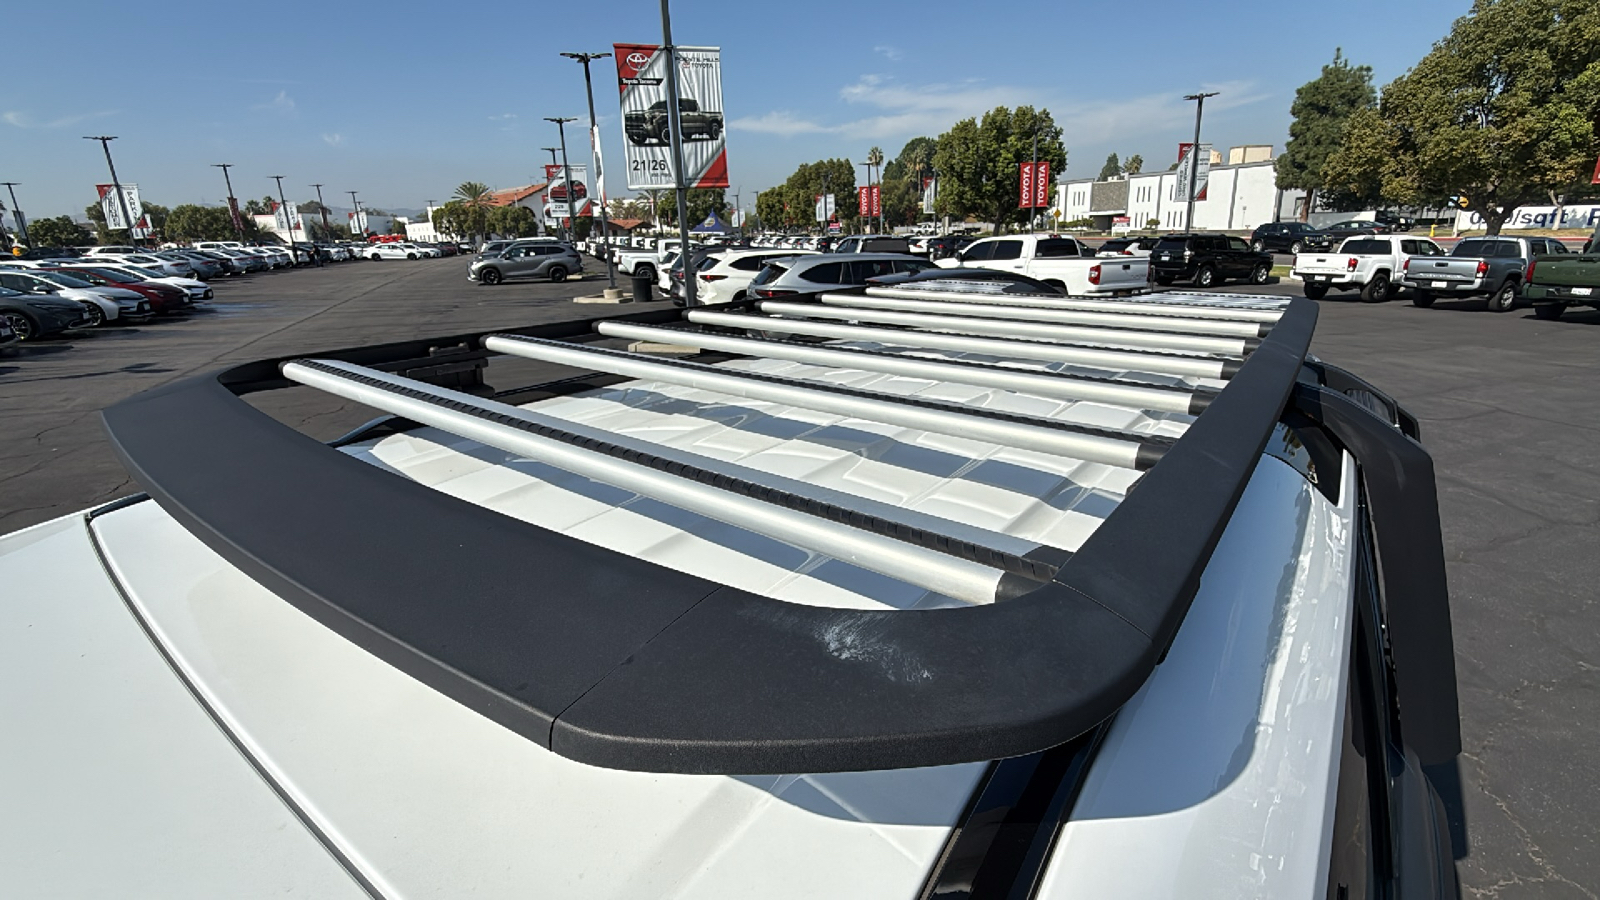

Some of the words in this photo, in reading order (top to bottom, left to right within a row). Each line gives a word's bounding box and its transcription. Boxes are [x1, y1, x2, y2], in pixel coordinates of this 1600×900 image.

[632, 159, 666, 171] 21/26
[1022, 165, 1031, 206] TOYOTA
[1037, 164, 1046, 205] TOYOTA
